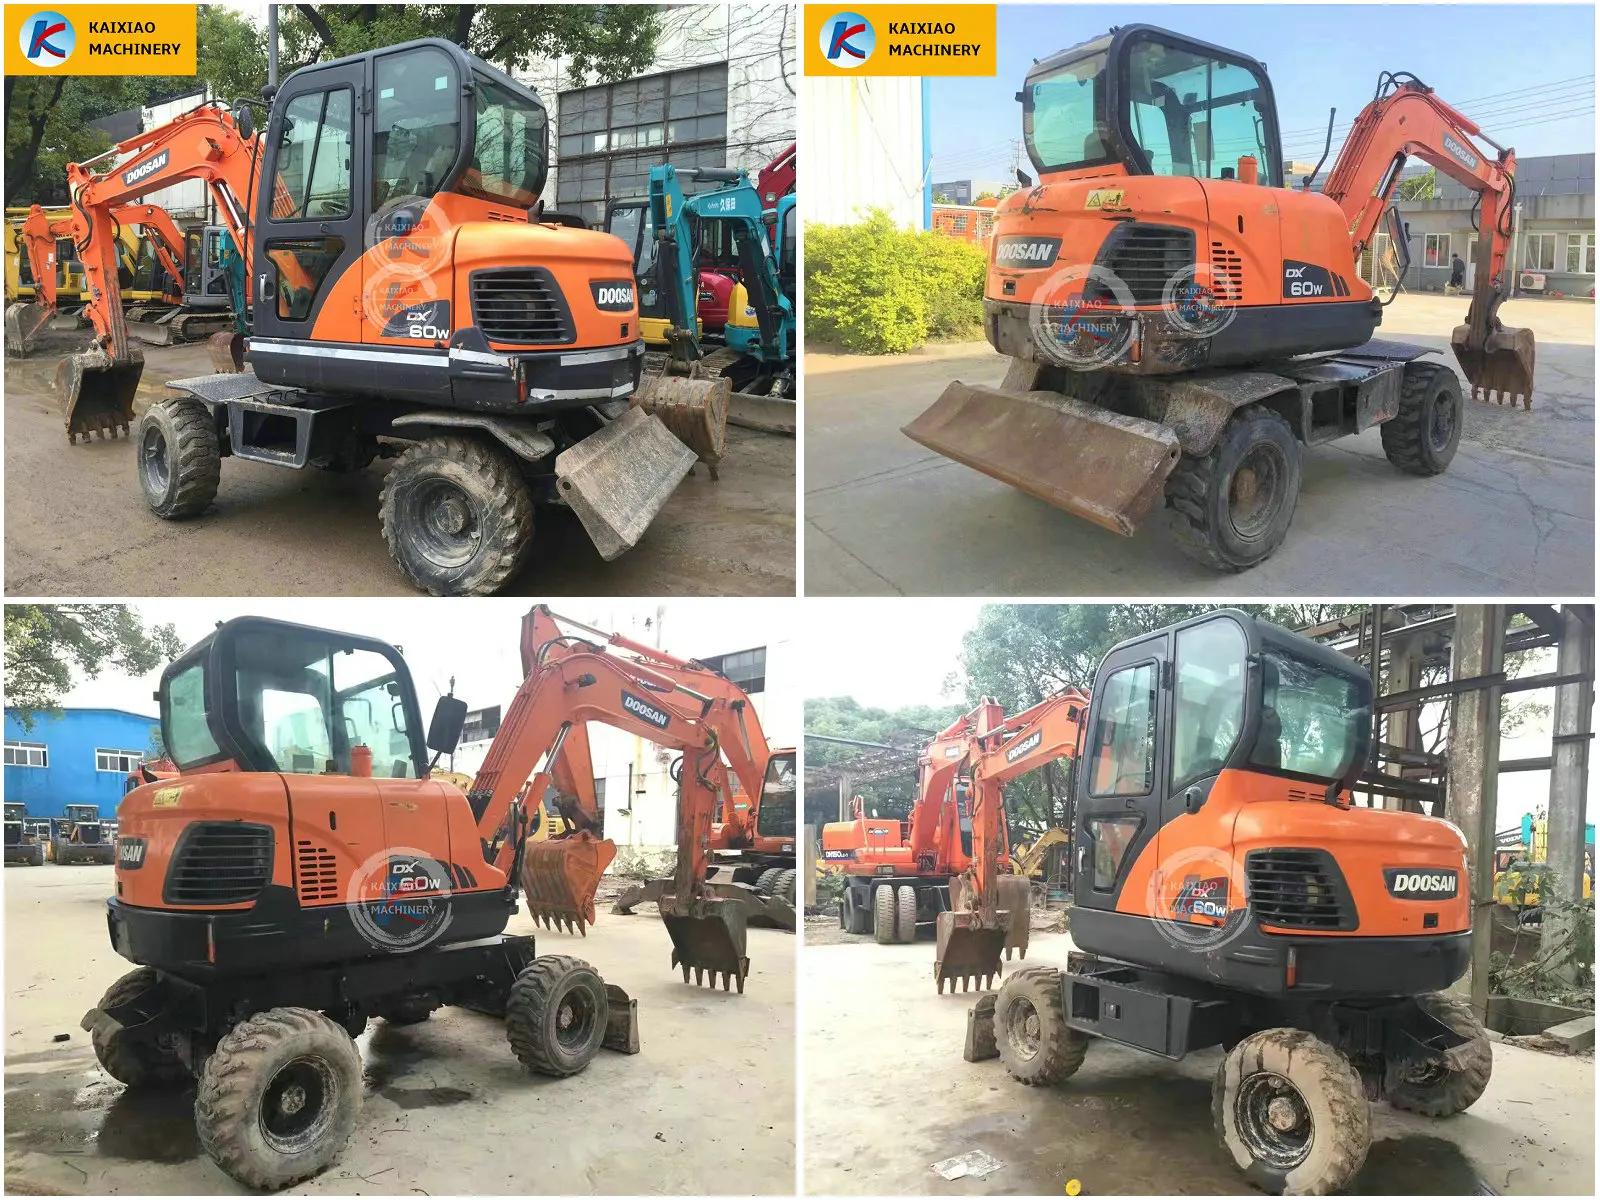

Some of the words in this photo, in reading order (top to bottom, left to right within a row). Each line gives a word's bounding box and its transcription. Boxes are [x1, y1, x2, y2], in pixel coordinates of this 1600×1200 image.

[1444, 137, 1476, 168] DOOSAN
[126, 153, 166, 184] DOOSAN
[1285, 266, 1308, 278] DX
[625, 696, 667, 726] DOOSAN
[1008, 733, 1040, 761] DOOSAN
[1499, 834, 1523, 844] VOLV
[392, 860, 420, 874] DX
[1394, 874, 1456, 892] DOOSAN
